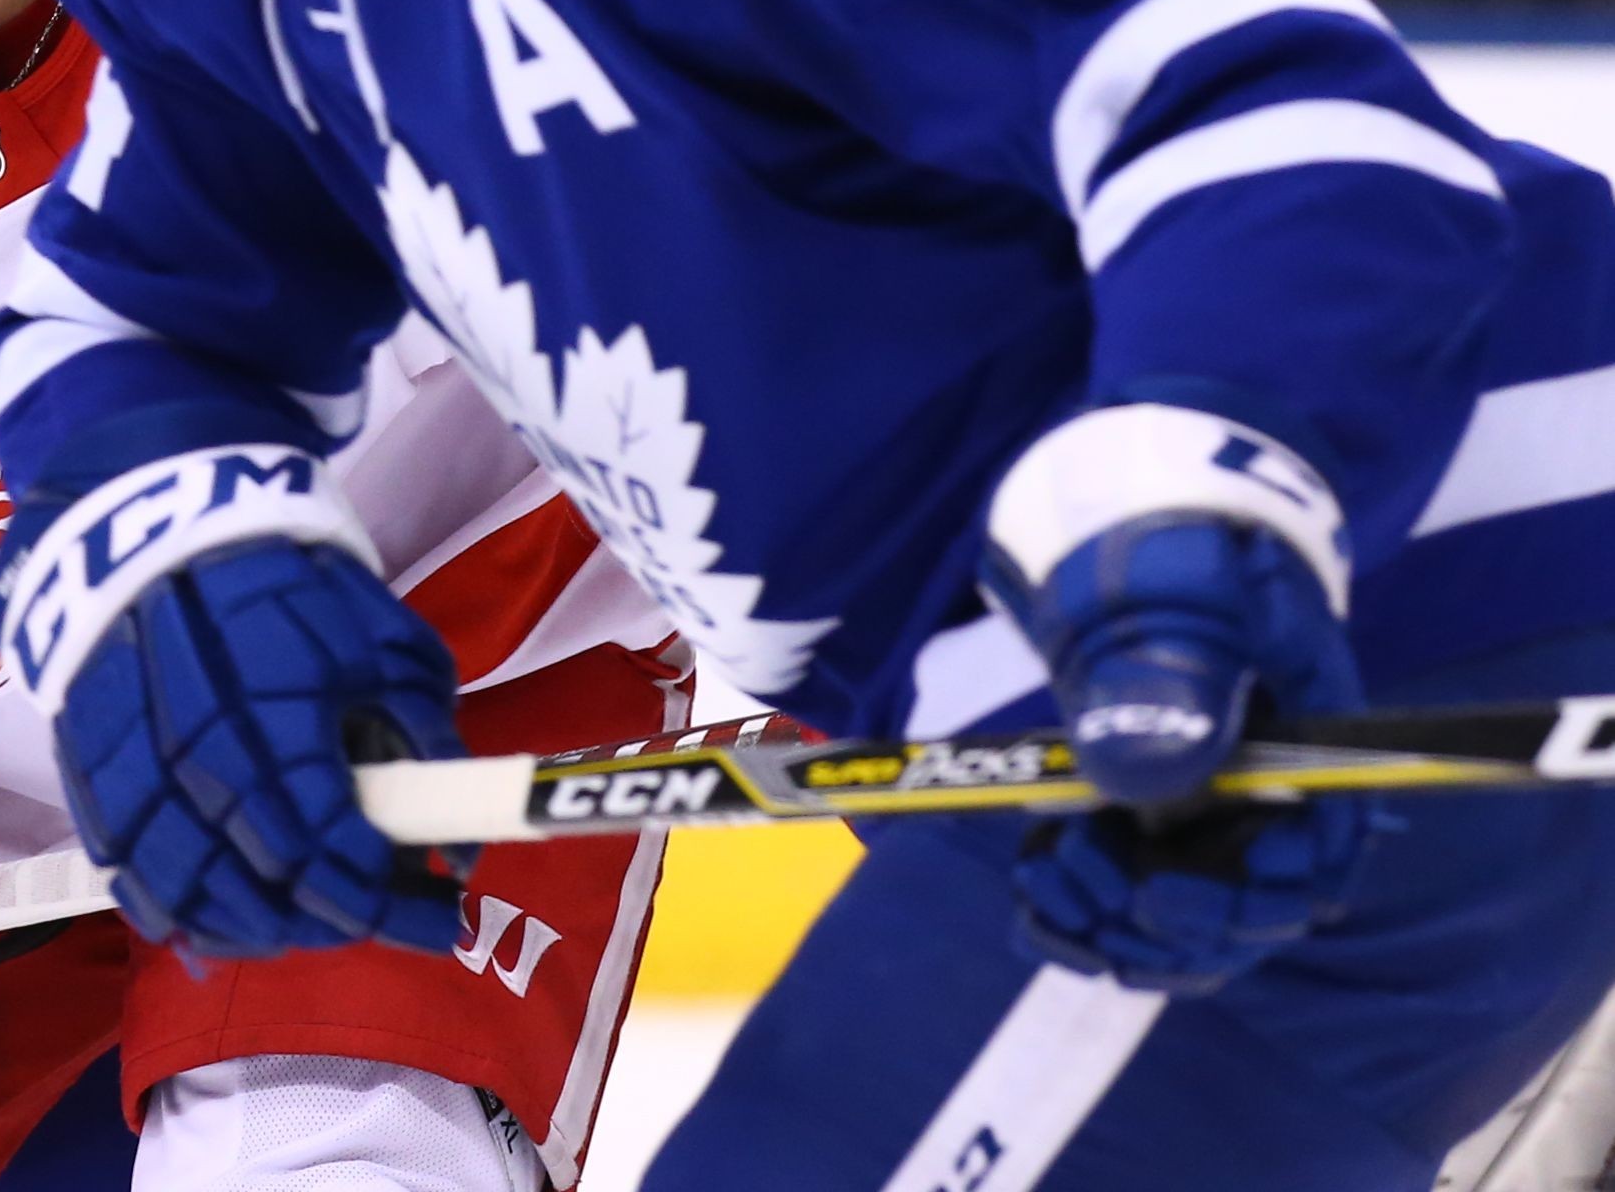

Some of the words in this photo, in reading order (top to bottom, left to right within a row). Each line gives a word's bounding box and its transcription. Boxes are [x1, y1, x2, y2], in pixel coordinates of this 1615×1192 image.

[12, 455, 314, 694] CCM
[545, 768, 723, 817] CCM
[500, 1112, 519, 1155] XL
